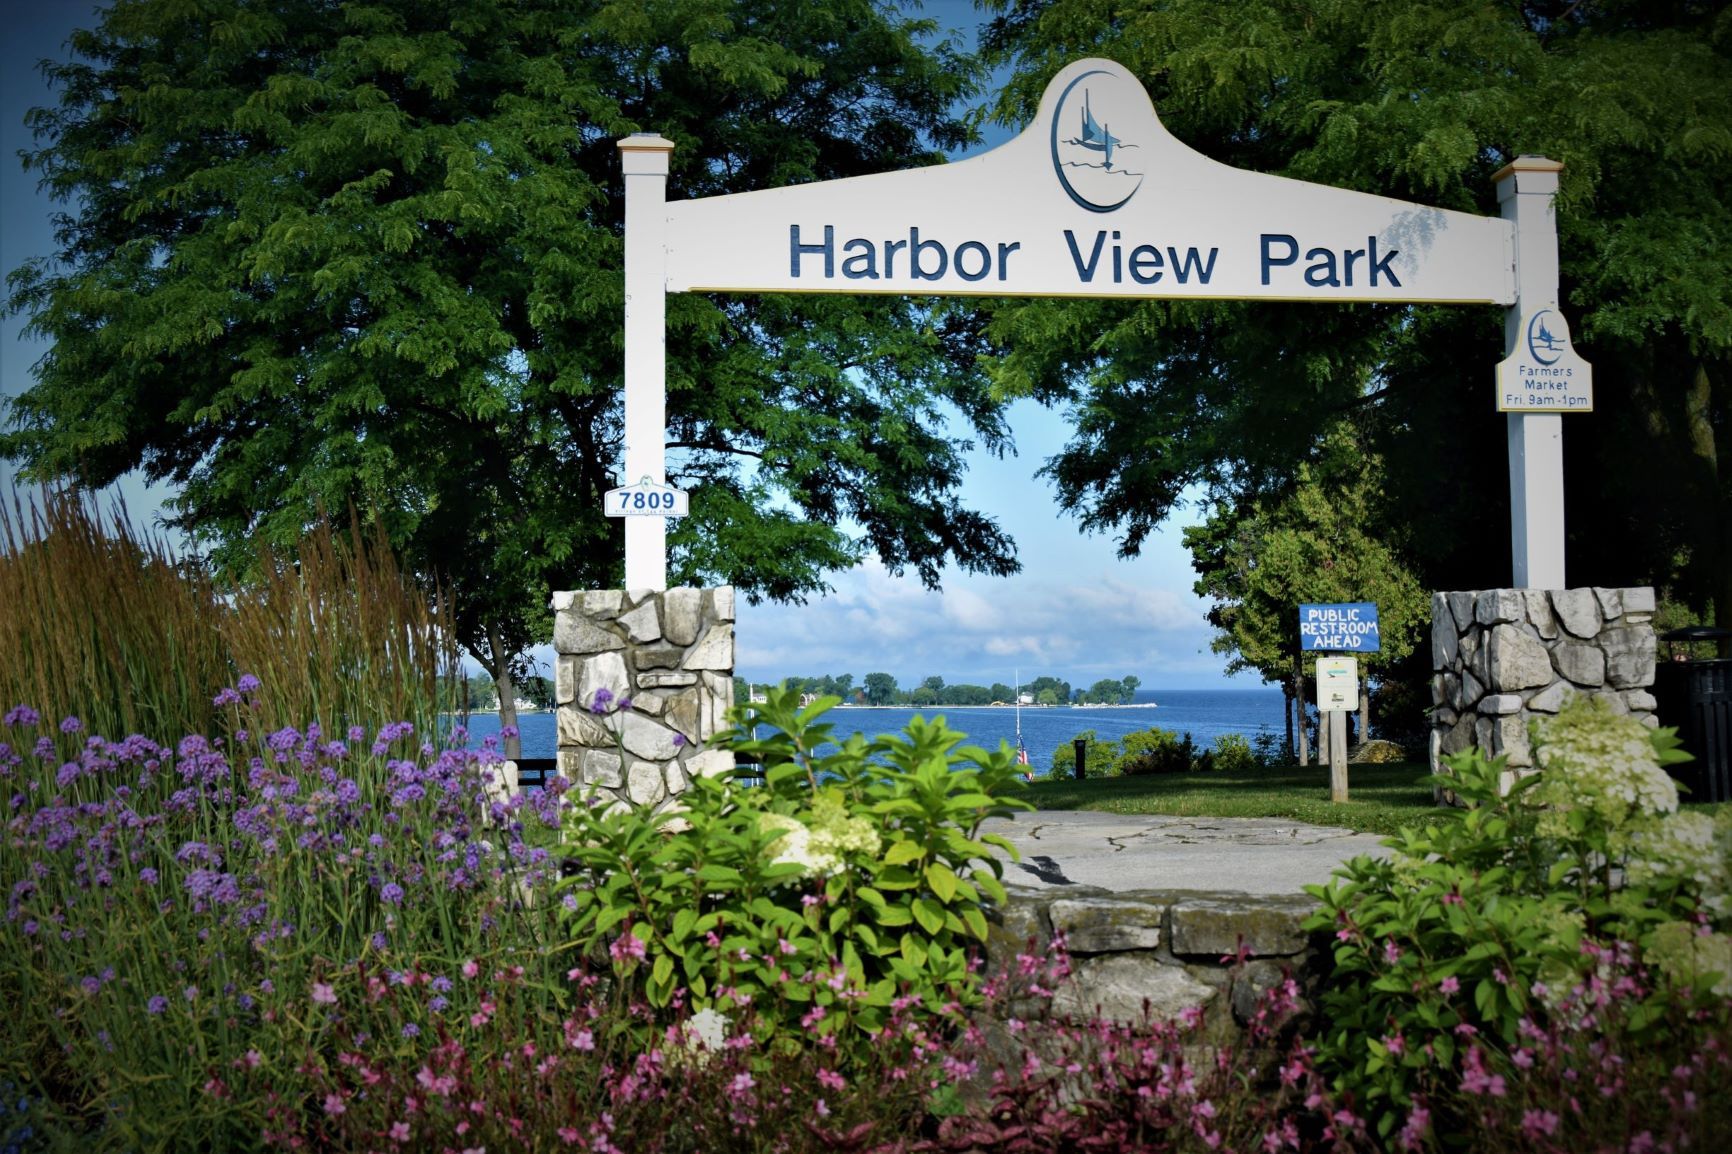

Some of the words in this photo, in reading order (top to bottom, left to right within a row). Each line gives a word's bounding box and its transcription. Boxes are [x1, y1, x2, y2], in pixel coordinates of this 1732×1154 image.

[789, 224, 1021, 282] Harbor
[1063, 230, 1219, 285] View
[1259, 233, 1402, 287] Park
[1519, 365, 1573, 377] Farmers
[1524, 379, 1568, 391] Market
[618, 491, 675, 509] 7809
[1308, 608, 1360, 622] PUBLIC
[1301, 621, 1379, 636] RESTROOM
[1313, 635, 1362, 648] AHEAD
